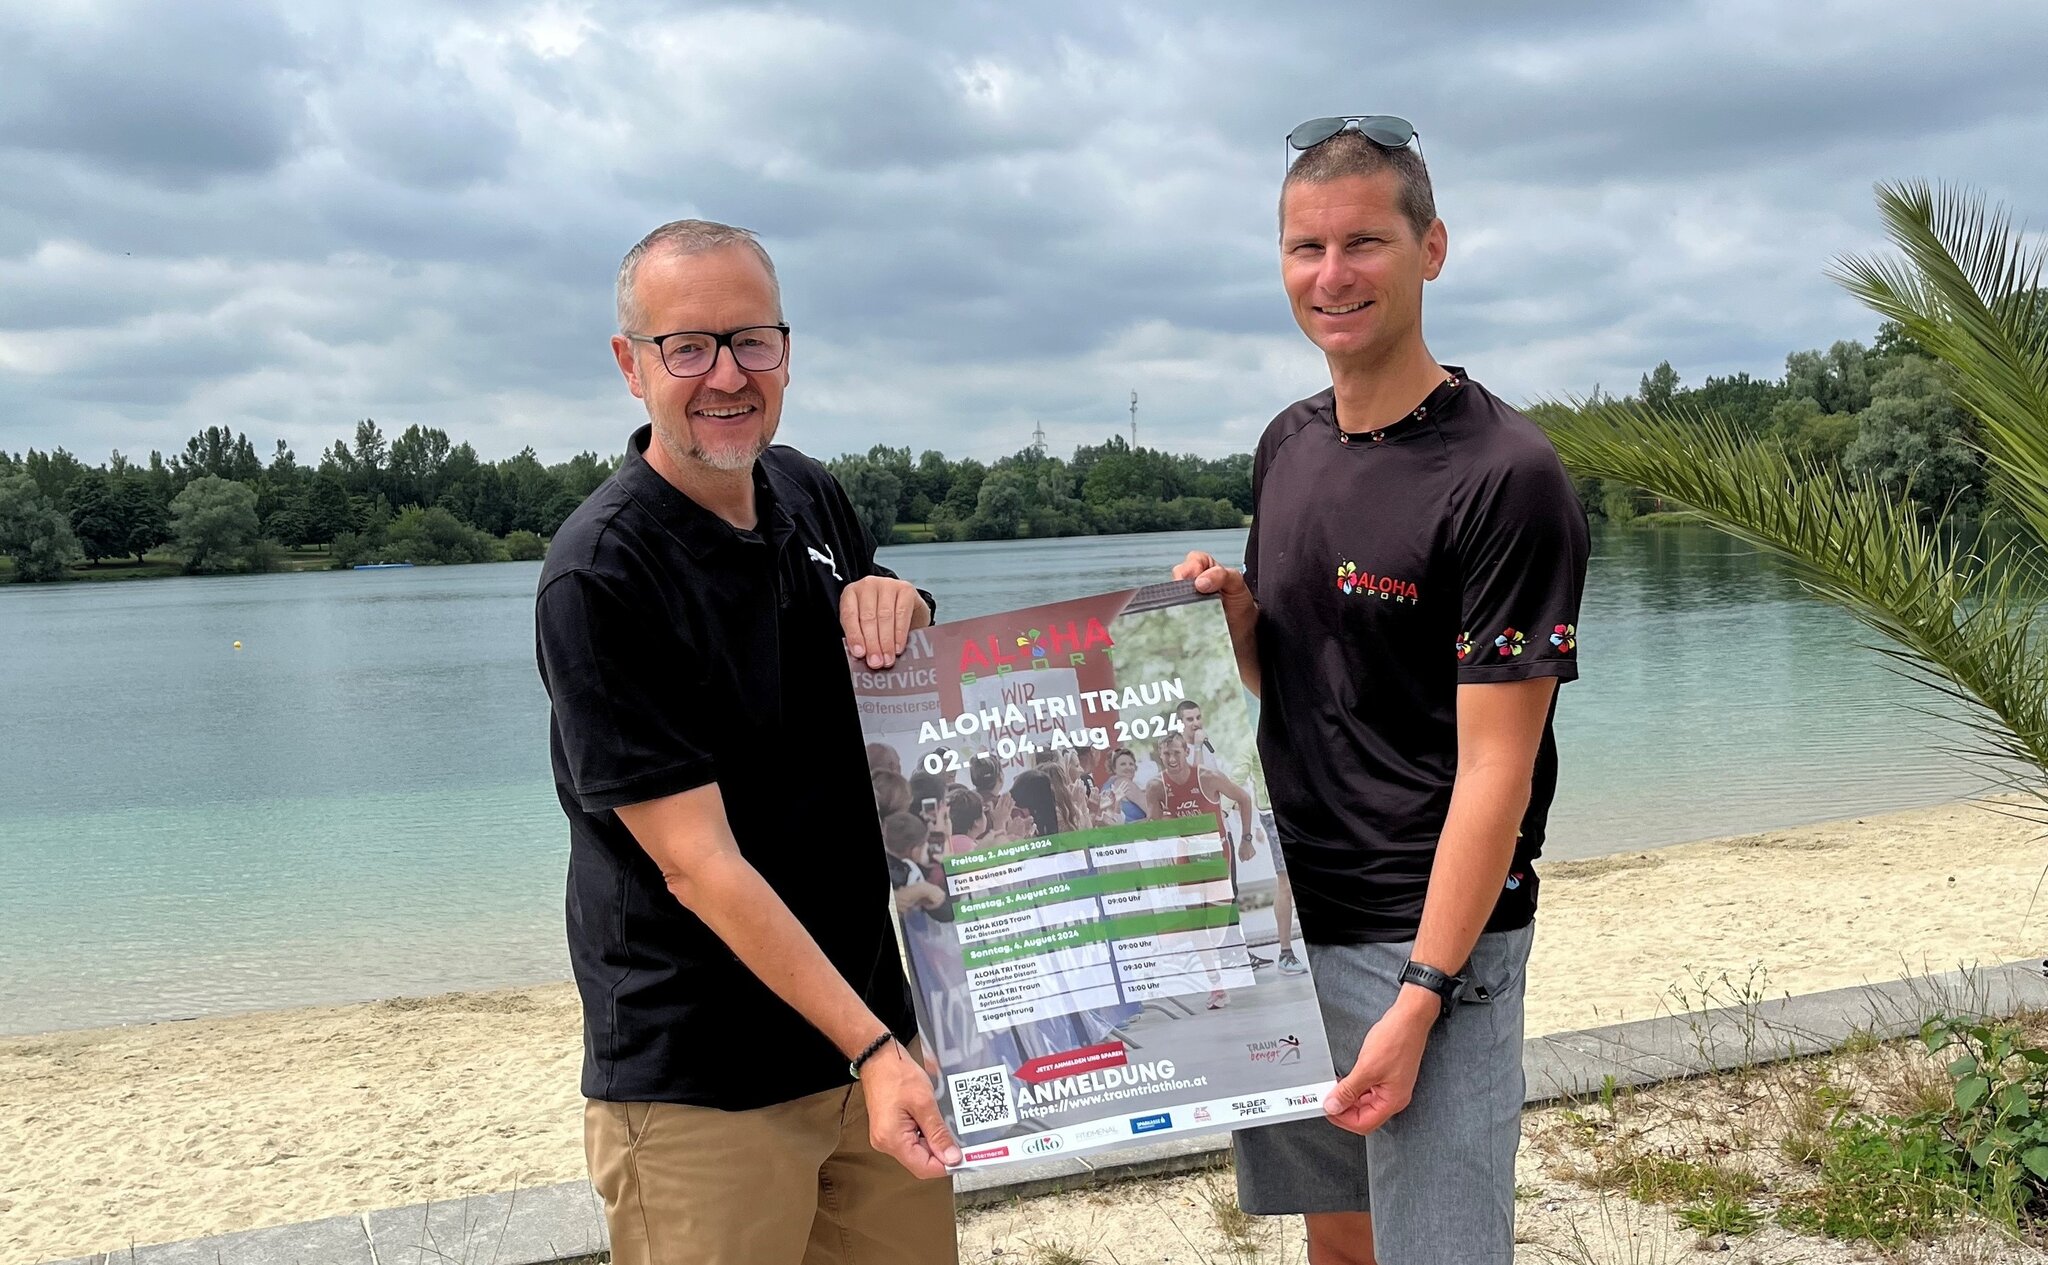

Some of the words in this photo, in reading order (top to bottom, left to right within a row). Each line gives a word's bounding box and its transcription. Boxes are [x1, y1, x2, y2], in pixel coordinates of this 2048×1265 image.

[1358, 572, 1418, 598] ALOHA
[1356, 586, 1418, 605] SPORT
[961, 647, 1121, 685] SPORT
[918, 702, 1026, 744] ALOHA
[1027, 694, 1077, 720] TRI
[1080, 677, 1185, 714] TRAUN
[924, 749, 971, 775] 02.
[997, 734, 1044, 760] 04.
[1050, 726, 1110, 750] Aug
[1114, 712, 1185, 742] 2024
[951, 851, 987, 867] Freitag,
[997, 843, 1030, 858] August
[1030, 839, 1052, 850] 2024
[1115, 847, 1128, 855] Uhr
[954, 878, 968, 886] Fun
[975, 870, 1007, 881] Business
[1008, 866, 1022, 874] Run
[960, 897, 1004, 913] Samstag,
[1015, 888, 1048, 903] August
[1048, 884, 1071, 895] 2024
[1107, 896, 1127, 906] 09:00
[1128, 894, 1141, 902] Uhr
[964, 923, 990, 934] ALOHA
[991, 919, 1009, 928] KIDS
[1009, 914, 1032, 924] Traun
[970, 944, 1013, 959] Sonntag,
[1014, 942, 1022, 950] 4.
[1023, 935, 1057, 949] August
[1057, 930, 1079, 941] 2024
[1118, 942, 1138, 951] 09:00
[1139, 940, 1152, 948] Uhr
[974, 969, 999, 980] ALOHA
[1000, 966, 1013, 974] TRI
[1013, 961, 1036, 971] Traun
[1123, 963, 1143, 972] 09:30
[978, 991, 1004, 1001] ALOHA
[1005, 987, 1018, 995] TRI
[1018, 982, 1041, 992] Traun
[1146, 982, 1160, 990] Uhr
[982, 1006, 1034, 1022] Siegerehrung
[1246, 1040, 1277, 1052] TRAUN
[1035, 1064, 1053, 1074] JETZT
[1054, 1057, 1087, 1069] ANMELDEN
[1087, 1054, 1100, 1063] UND
[1100, 1050, 1124, 1060] SPAREN
[1250, 1050, 1281, 1063] bewegt
[1017, 1059, 1176, 1108] ANMELDUNG
[1019, 1075, 1208, 1119] https://www.trauntriathlon.at
[1232, 1098, 1266, 1110] SILBER
[1240, 1106, 1266, 1116] PFEIL
[1027, 1137, 1060, 1154] efko
